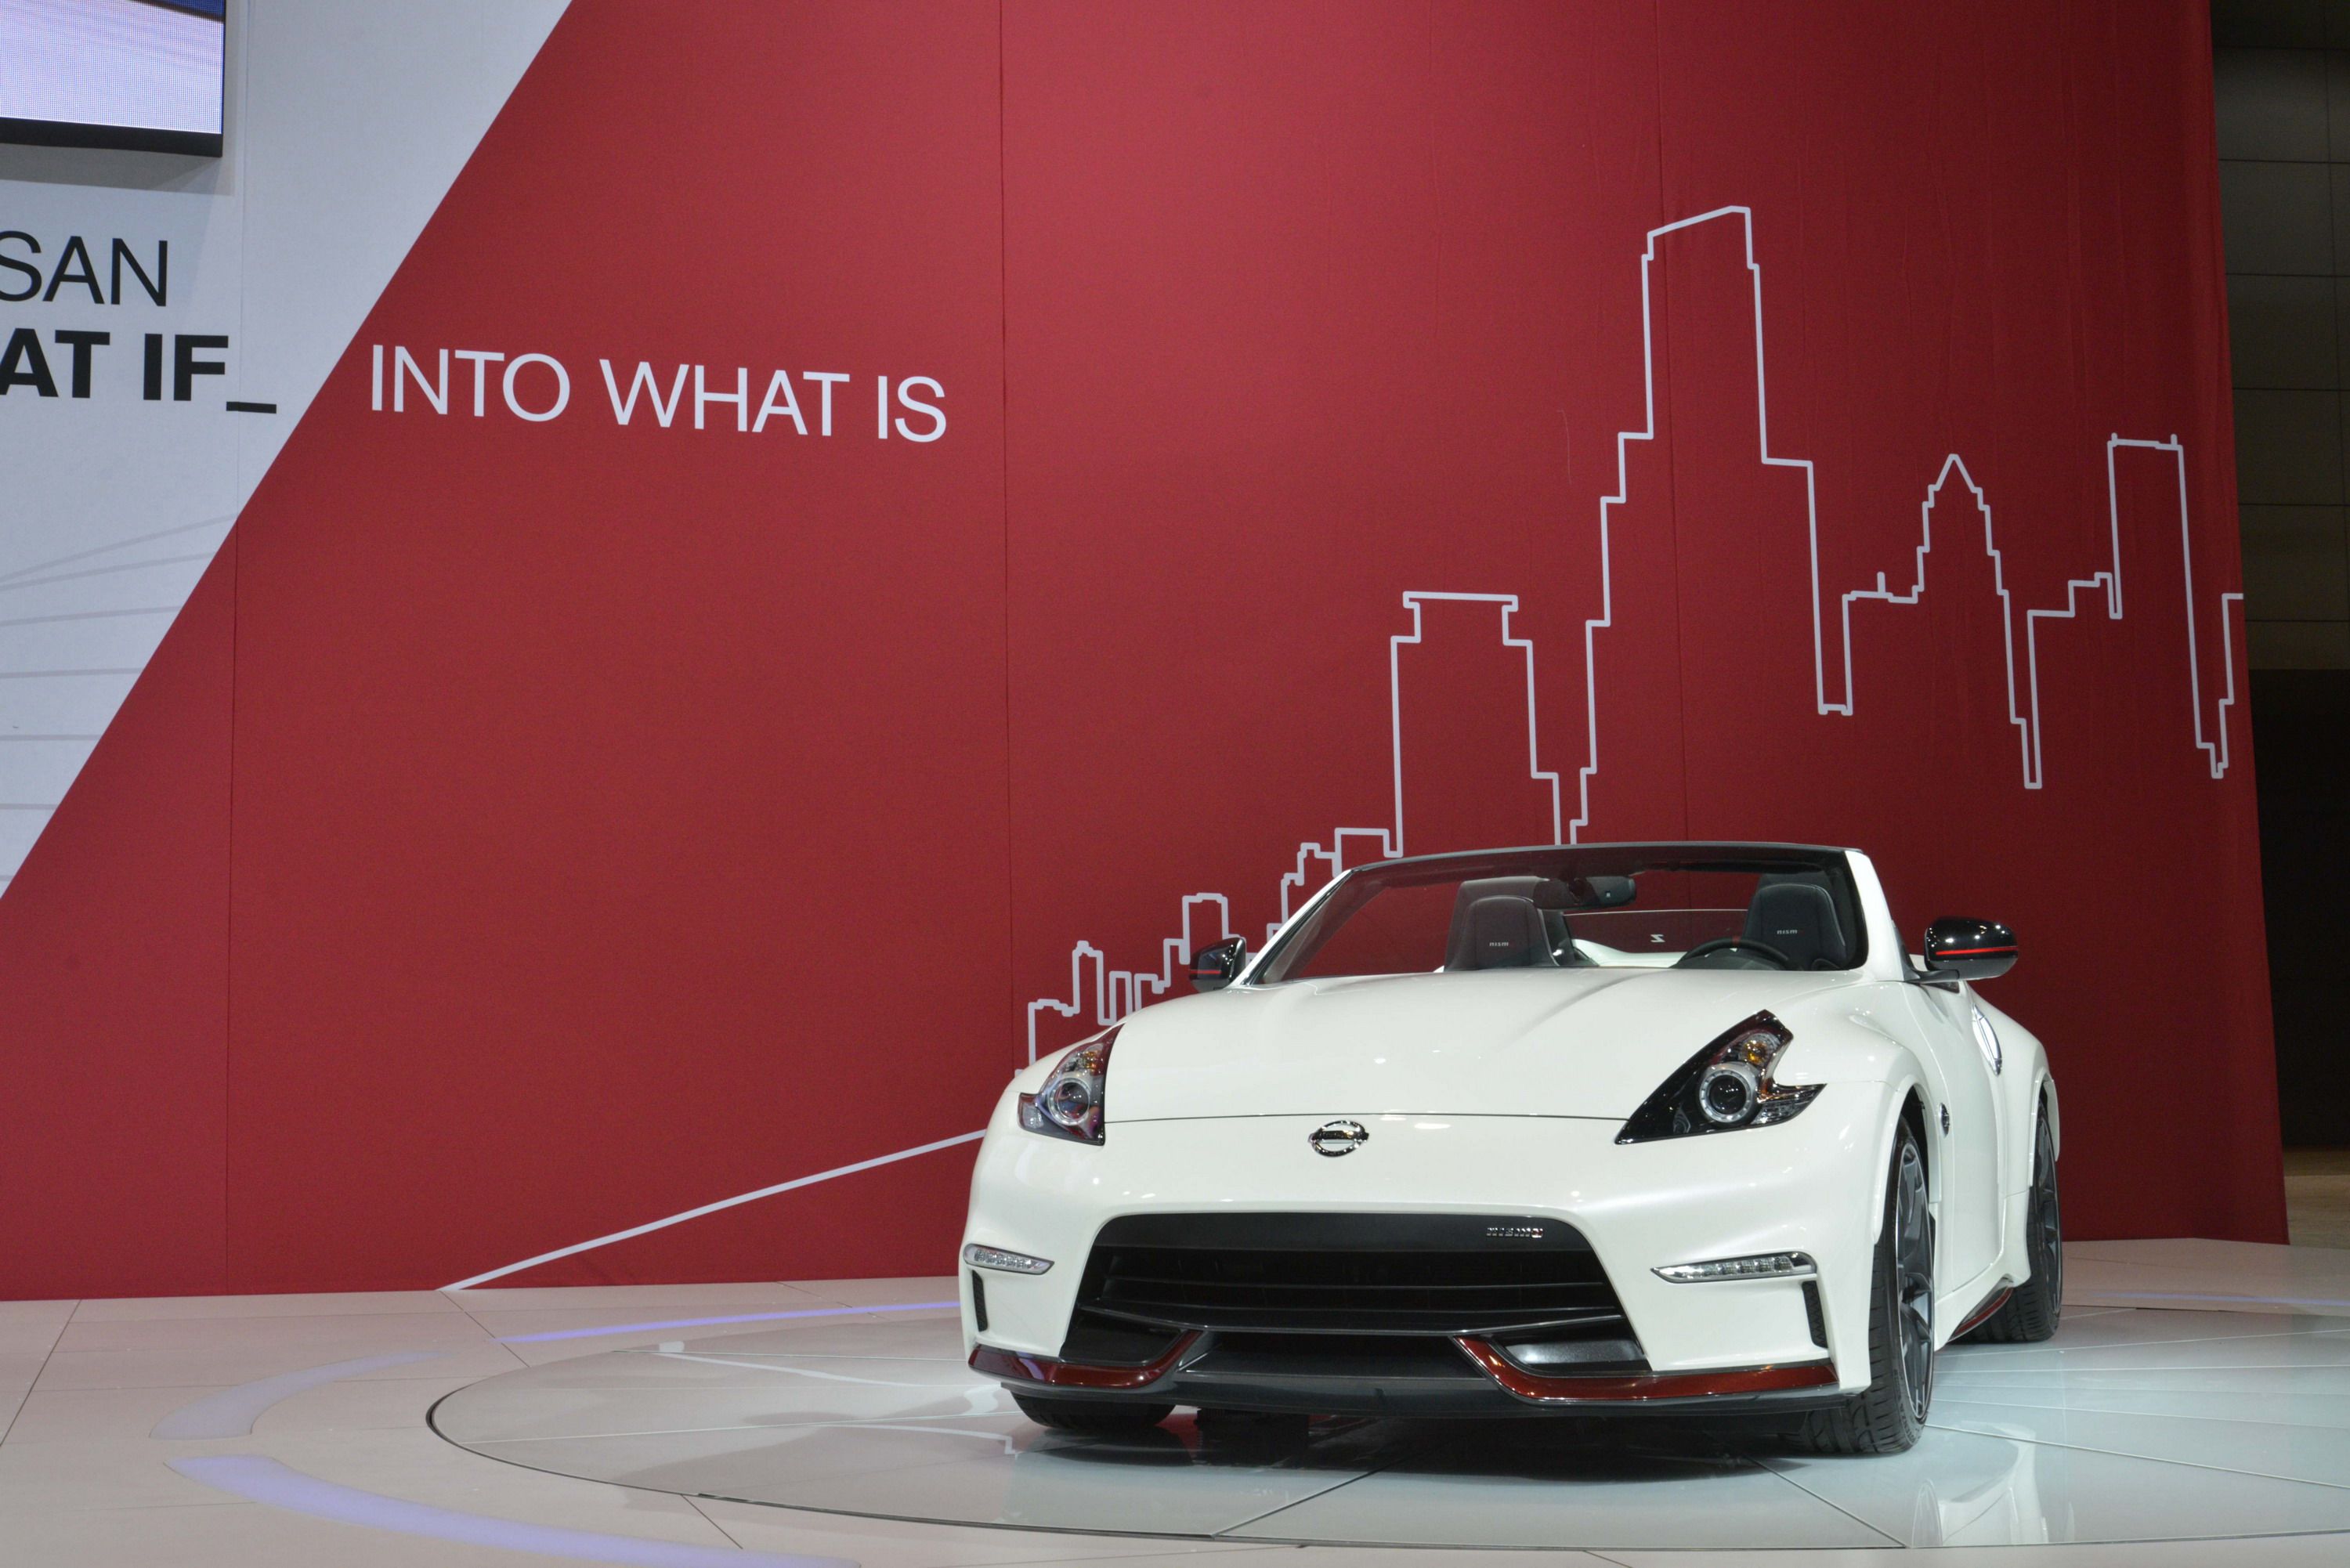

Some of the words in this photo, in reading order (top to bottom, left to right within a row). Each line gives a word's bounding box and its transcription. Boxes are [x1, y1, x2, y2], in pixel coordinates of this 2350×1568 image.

[0, 230, 168, 307] SAN
[0, 327, 110, 399] AT
[371, 344, 570, 422] INTO
[599, 359, 850, 437] WHAT
[877, 375, 947, 443] IS
